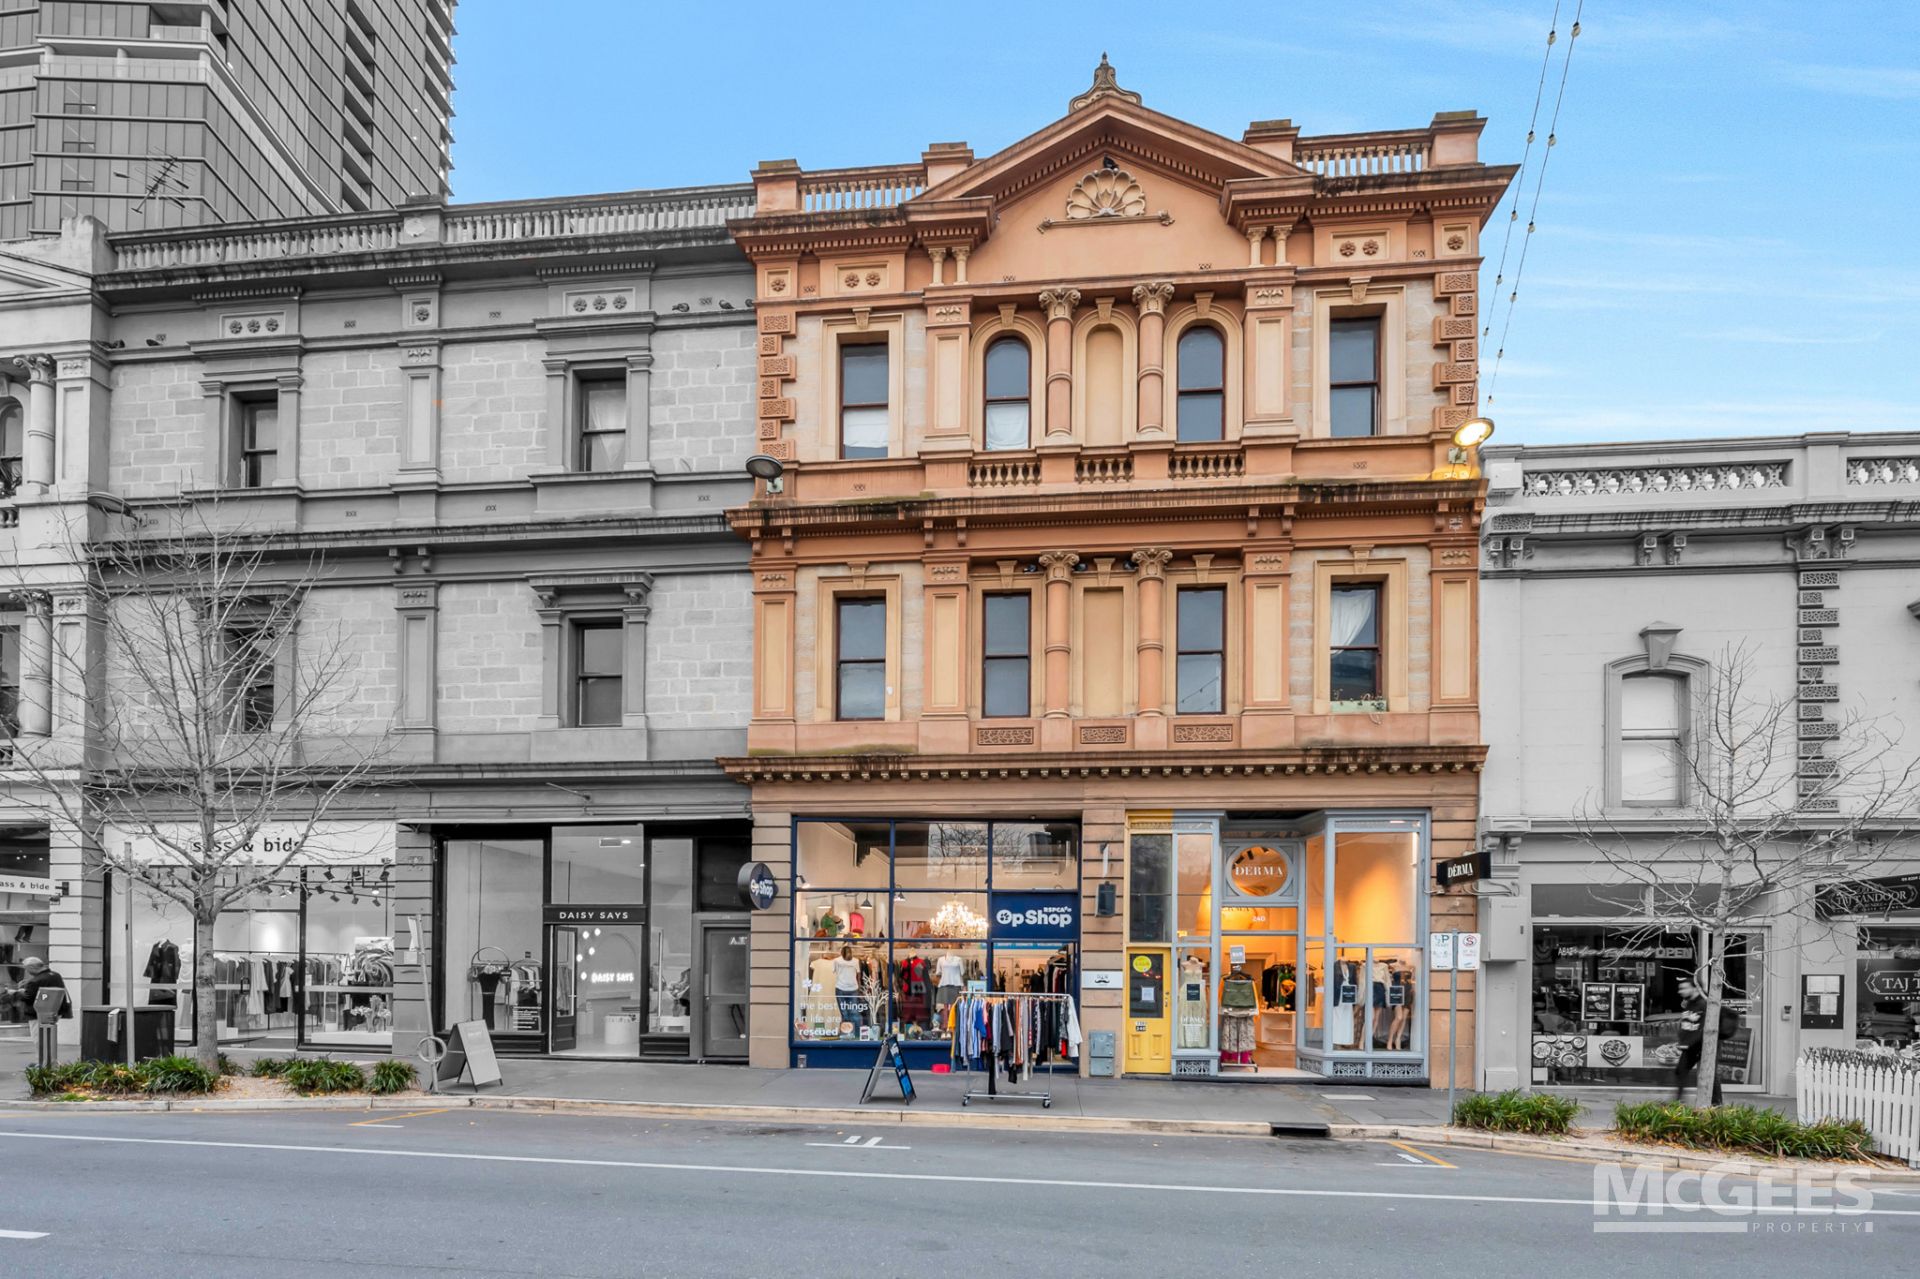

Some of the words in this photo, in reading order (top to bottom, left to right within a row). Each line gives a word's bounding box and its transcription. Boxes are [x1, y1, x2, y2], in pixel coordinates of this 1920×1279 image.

[559, 911, 595, 919] DAISY
[599, 911, 629, 919] SAYS
[1025, 909, 1072, 927] Shop
[1882, 977, 1909, 992] TAJ
[41, 993, 48, 1001] P
[840, 1001, 868, 1012] things
[800, 1027, 838, 1036] rescued
